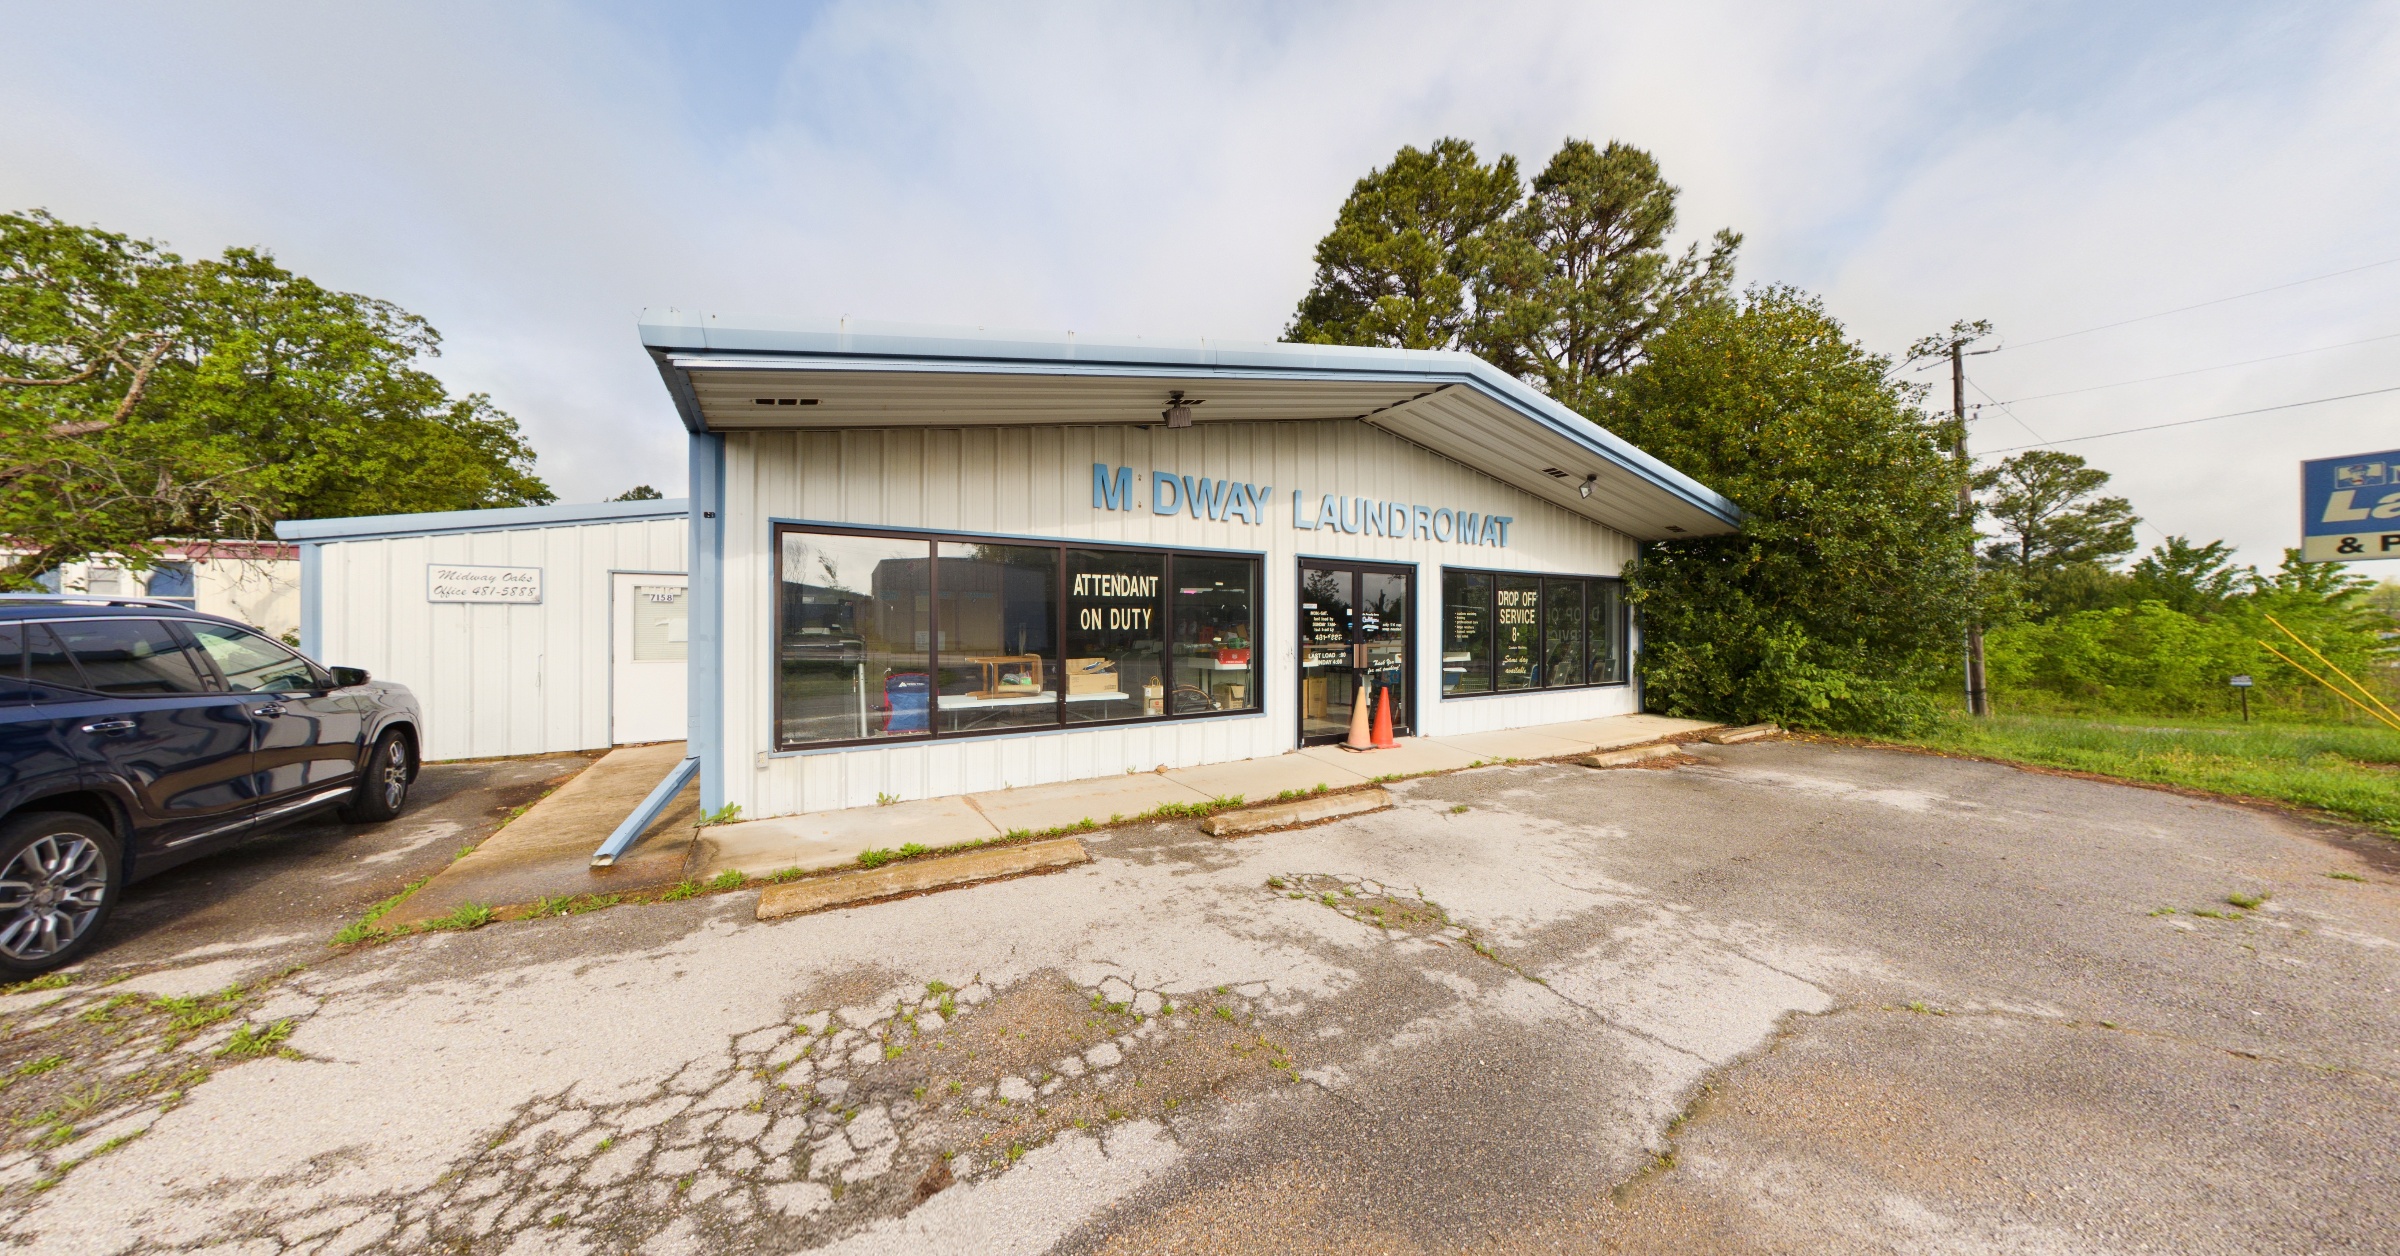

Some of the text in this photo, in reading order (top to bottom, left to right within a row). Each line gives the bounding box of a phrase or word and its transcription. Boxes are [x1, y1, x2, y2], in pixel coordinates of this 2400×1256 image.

[1092, 462, 1513, 549] MDWAY LAUNDROMAT
[2336, 534, 2400, 554] & P
[437, 569, 533, 584] Midway Oaks
[1073, 573, 1158, 598] ATTENDANT
[433, 585, 536, 598] Office 481-5888
[1498, 590, 1538, 607] DROP OFF
[1080, 608, 1152, 630] ON DUTY
[1499, 608, 1536, 625] SERVICE
